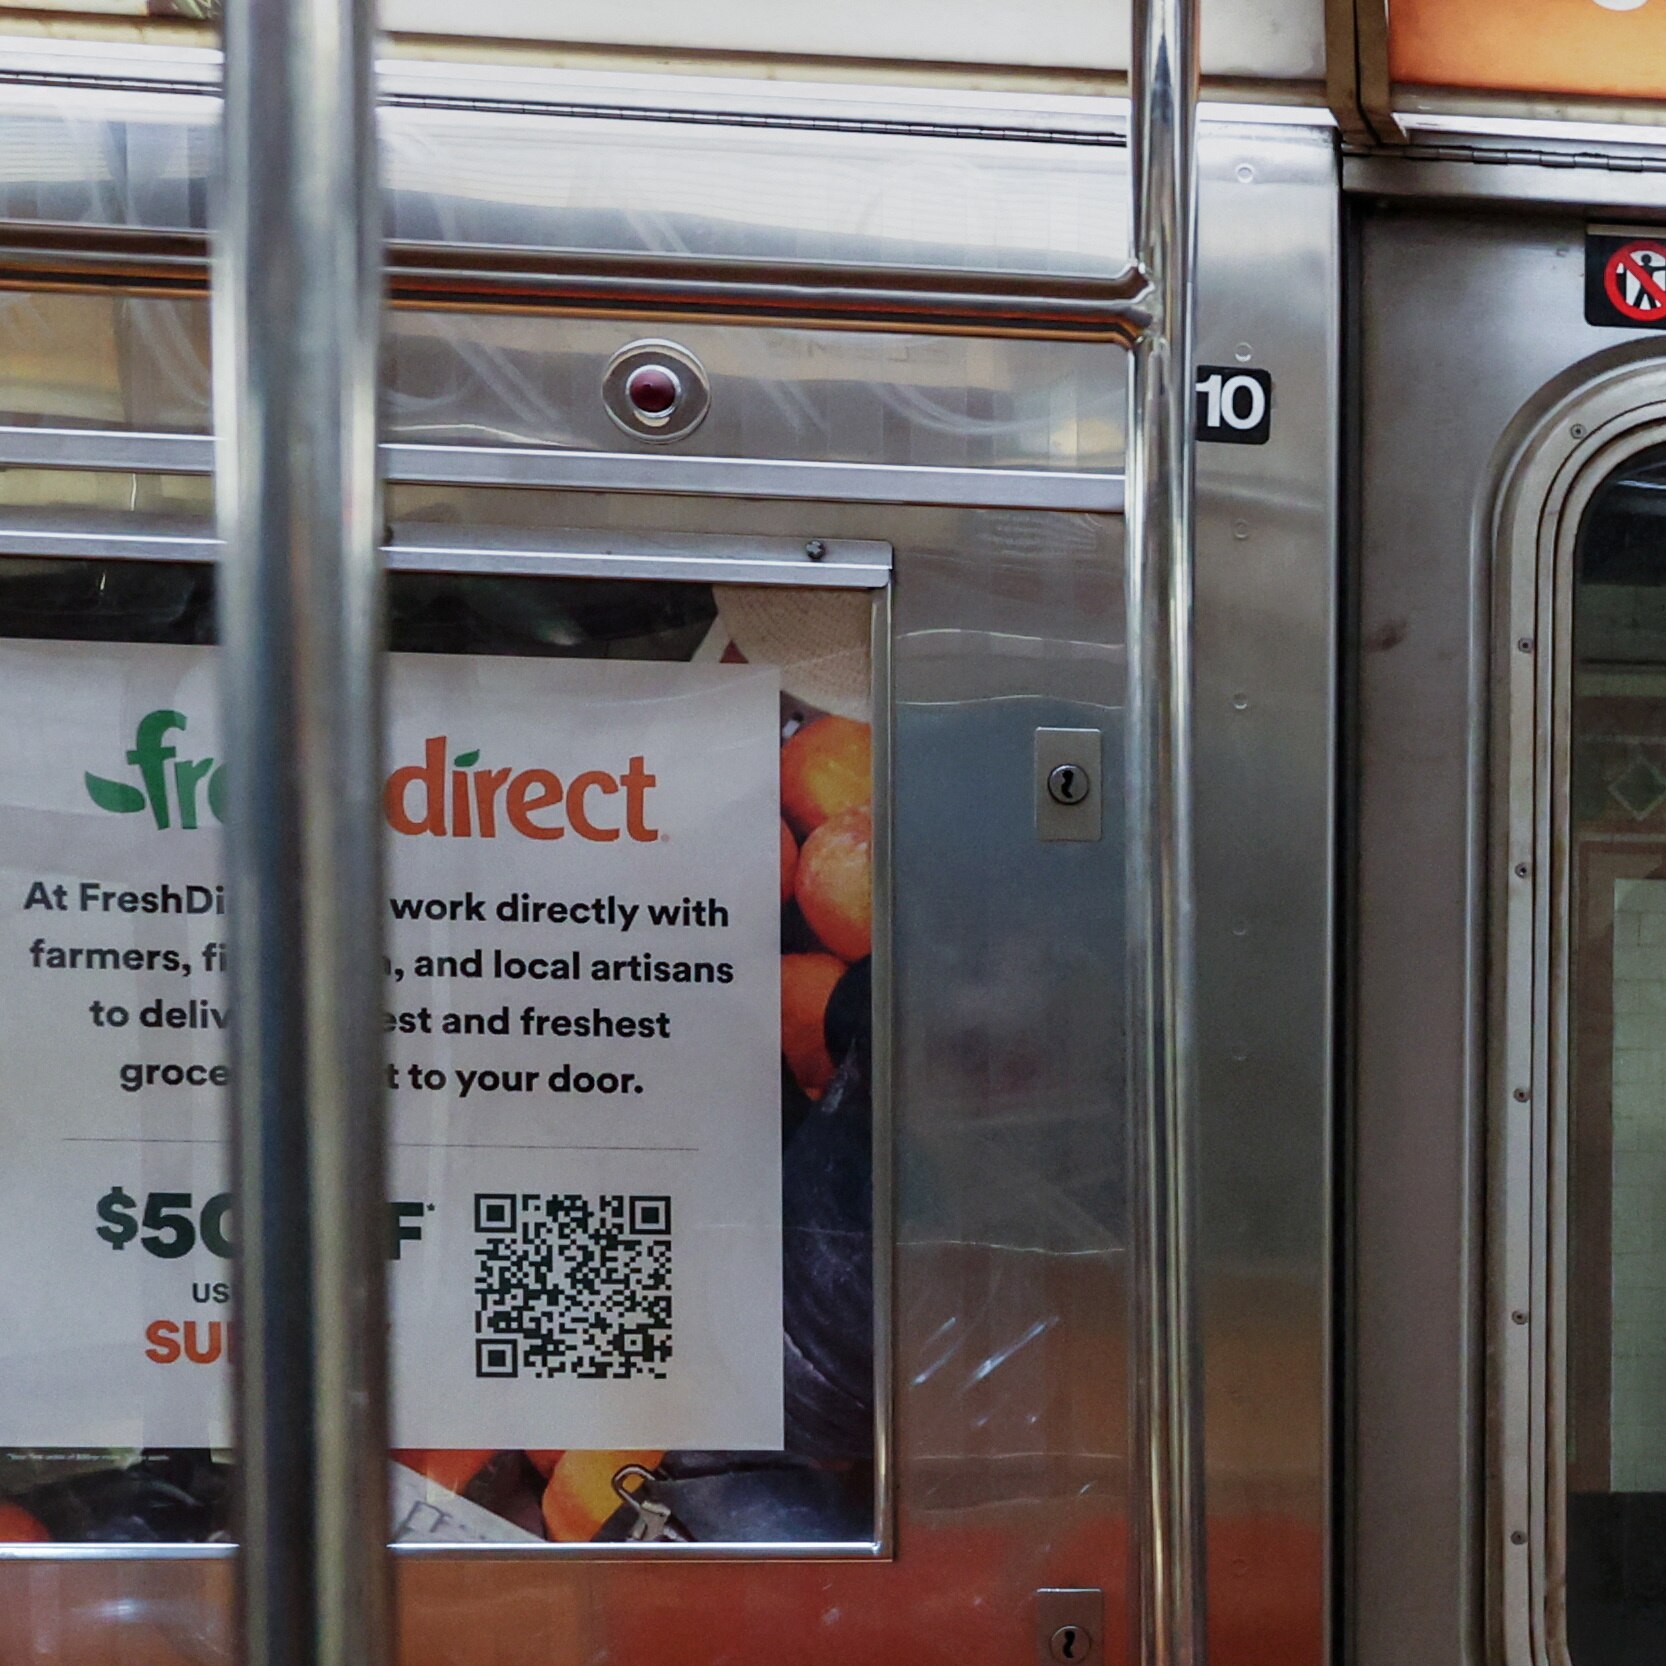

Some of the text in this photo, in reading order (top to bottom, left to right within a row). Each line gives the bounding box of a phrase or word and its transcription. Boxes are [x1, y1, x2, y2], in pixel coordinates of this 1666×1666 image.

[1195, 374, 1266, 430] 10
[125, 709, 659, 843] frdirect
[24, 881, 730, 933] At FreshDi work directly with
[29, 938, 192, 978] farmers,
[414, 949, 482, 979] and
[494, 949, 581, 981] local
[591, 953, 735, 984] artisans
[89, 998, 671, 1039] to deliv est and freshest
[120, 1062, 231, 1093] groce
[408, 1062, 447, 1092] to
[455, 1070, 540, 1098] your
[547, 1063, 644, 1094] door.
[192, 1282, 231, 1304] US
